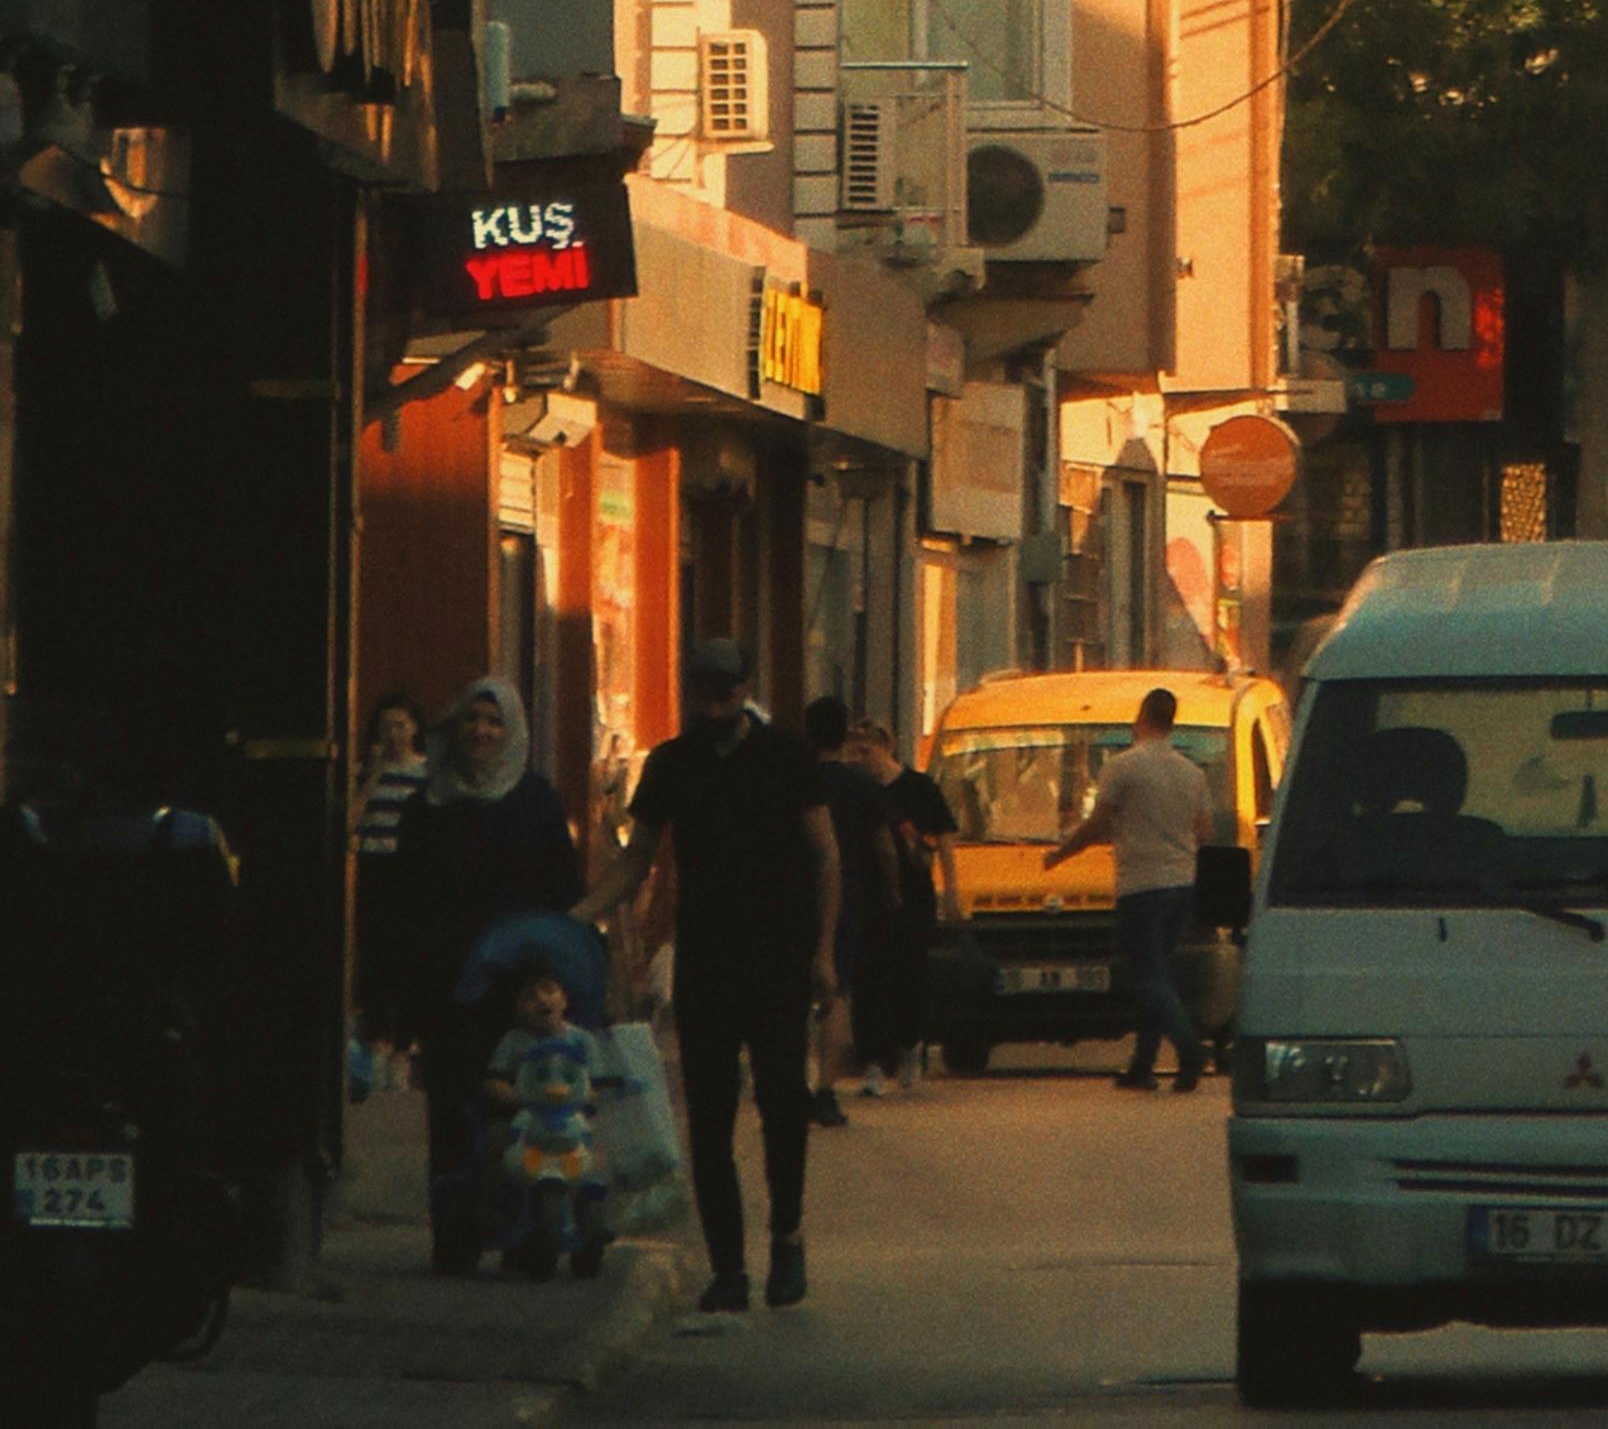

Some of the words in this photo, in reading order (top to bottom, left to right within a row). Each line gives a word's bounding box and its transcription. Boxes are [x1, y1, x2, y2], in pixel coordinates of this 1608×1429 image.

[472, 203, 574, 250] KUŞ
[466, 240, 589, 301] YEMİ
[1555, 1214, 1602, 1250] DZ
